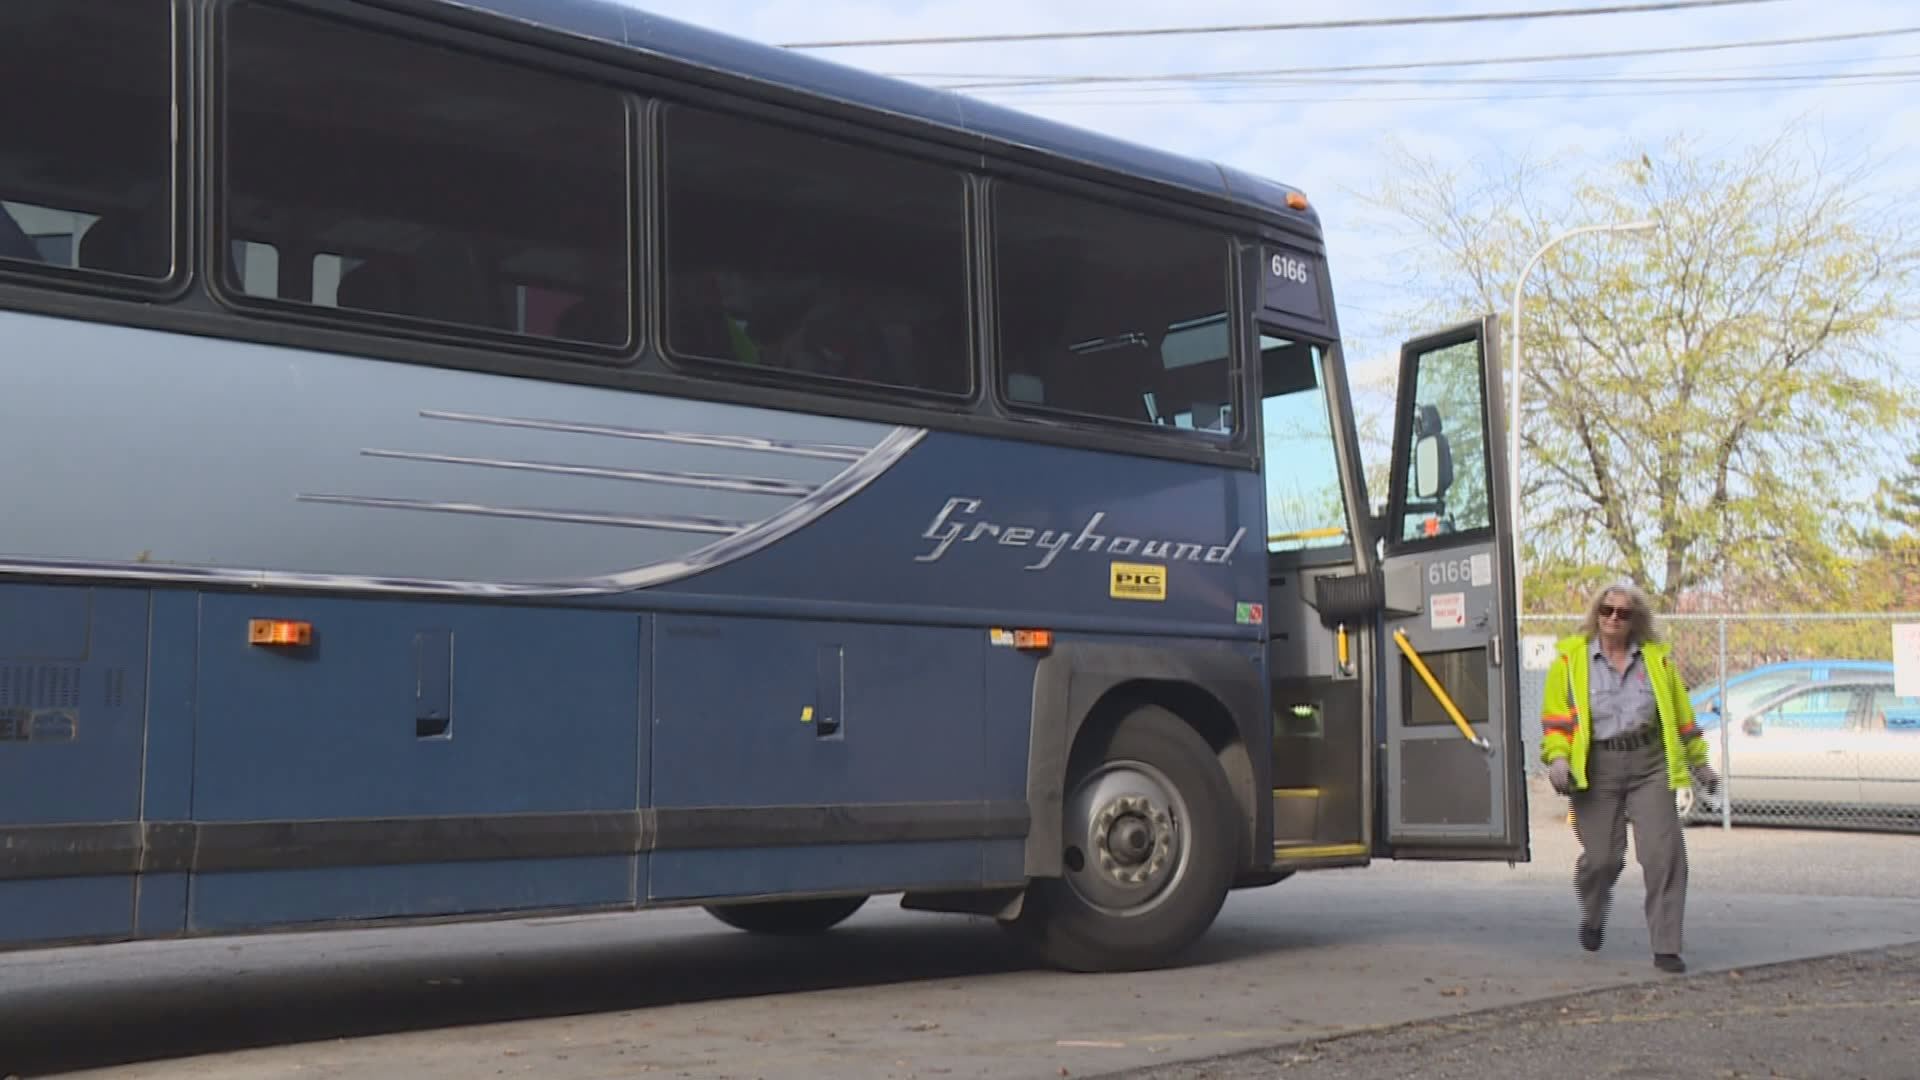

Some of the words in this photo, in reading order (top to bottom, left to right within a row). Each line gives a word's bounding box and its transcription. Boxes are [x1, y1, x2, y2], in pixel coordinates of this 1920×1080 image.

[1272, 254, 1307, 284] 6166
[914, 497, 1247, 570] Greyhound
[1116, 573, 1161, 585] PIC
[1429, 559, 1471, 585] 6166
